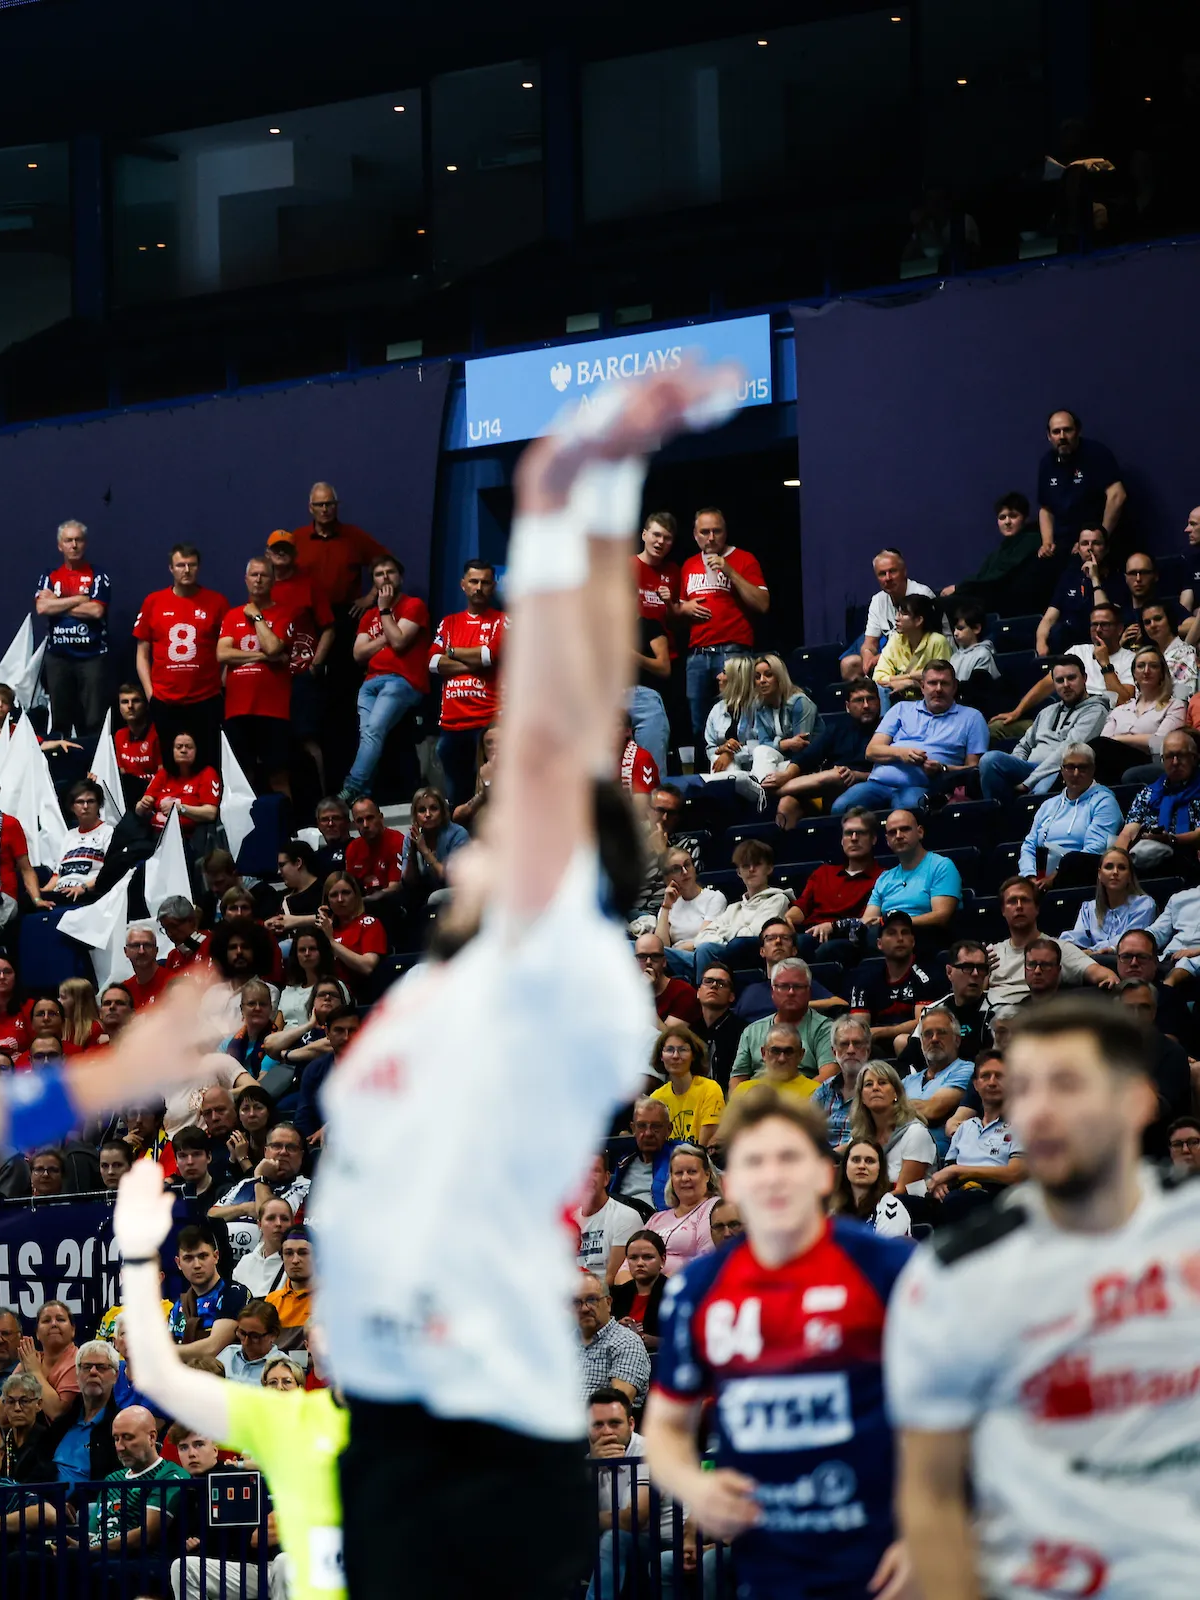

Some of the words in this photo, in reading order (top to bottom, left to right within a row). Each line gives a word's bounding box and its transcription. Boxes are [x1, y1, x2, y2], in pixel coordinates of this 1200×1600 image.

[577, 346, 681, 385] BARCLAYS
[737, 378, 769, 401] U15
[469, 418, 502, 441] U14
[53, 626, 77, 635] Nord
[53, 635, 90, 645] Schrott
[168, 622, 197, 662] 8
[446, 678, 472, 688] Nord
